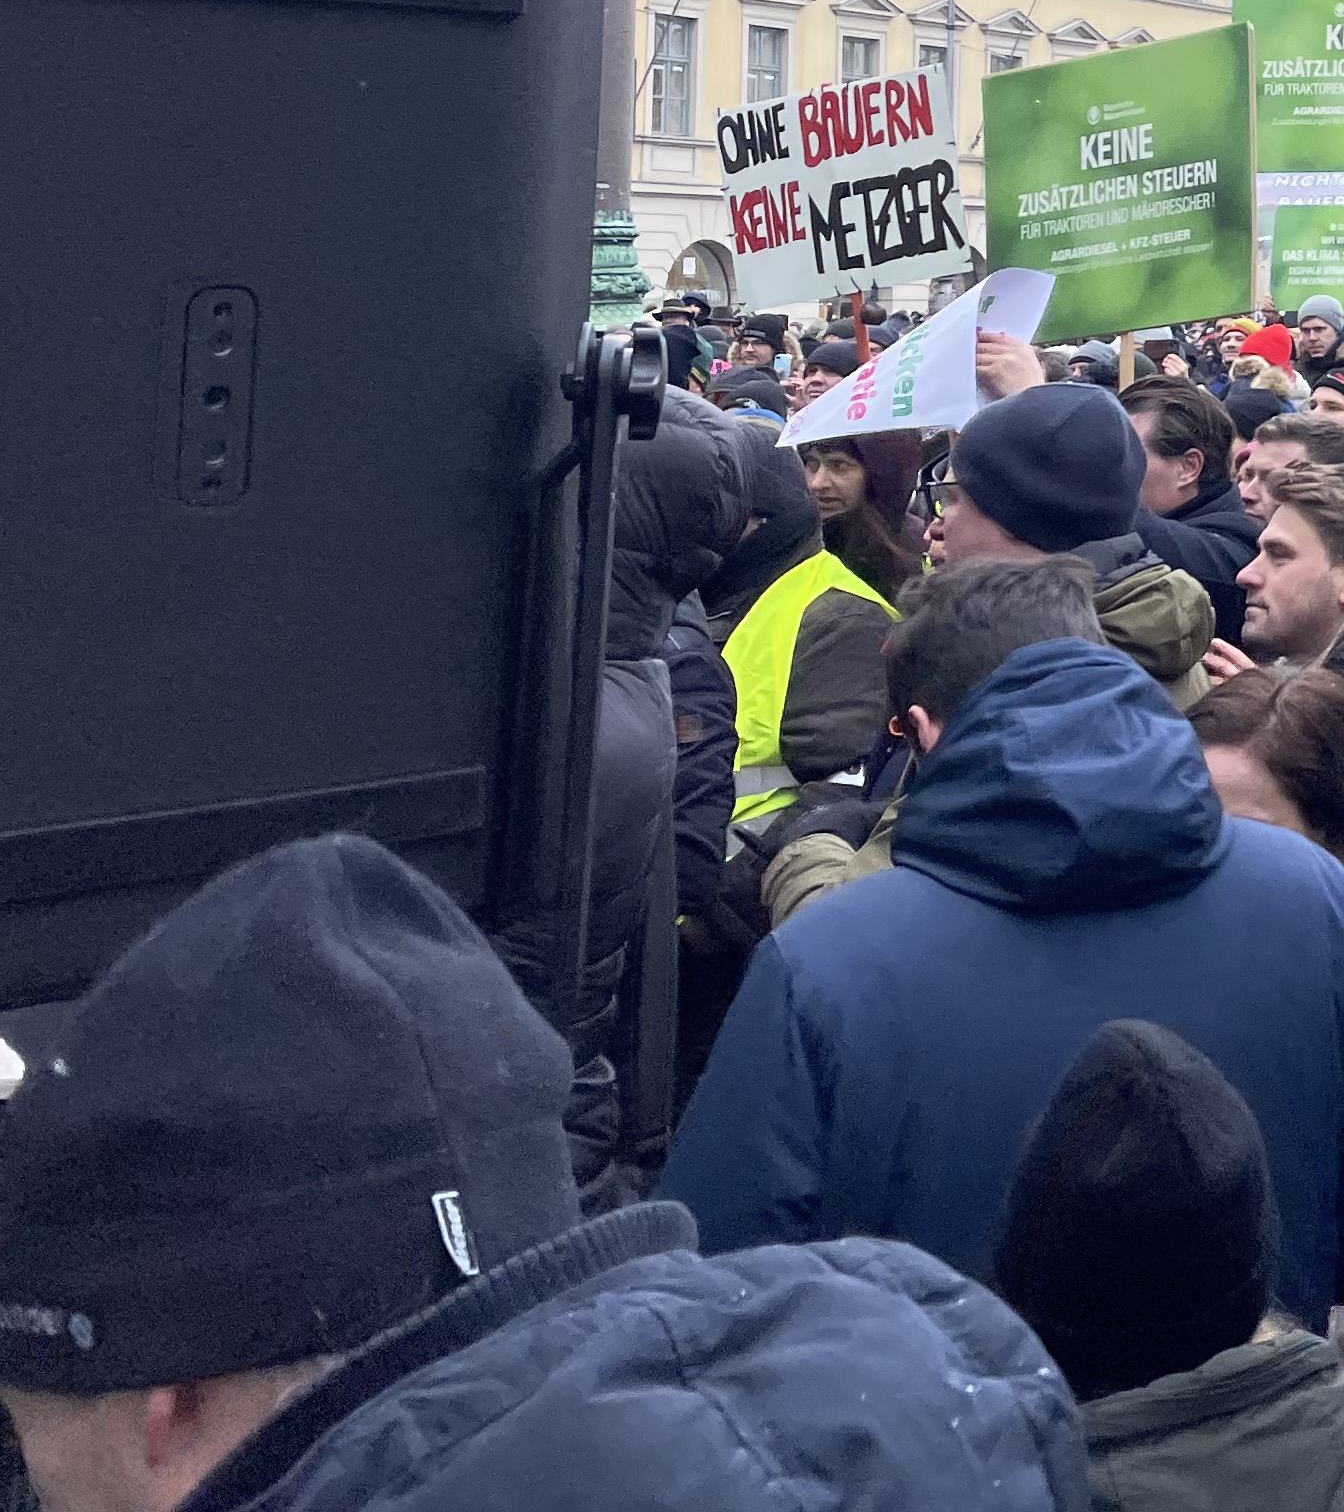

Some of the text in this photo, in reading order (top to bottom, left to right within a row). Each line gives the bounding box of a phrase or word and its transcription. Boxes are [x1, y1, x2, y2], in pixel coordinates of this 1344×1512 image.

[1264, 82, 1285, 96] FÜR
[717, 74, 935, 175] OHNE BAUERN
[1080, 123, 1154, 171] KEINE
[1018, 159, 1217, 217] ZUSÄTZLICHEN STEUERN
[730, 159, 966, 274] KEINE METZGER
[1020, 222, 1041, 240] FÜR
[1043, 213, 1104, 237] TRAKTOREN
[1107, 207, 1129, 226] UND
[1282, 249, 1304, 262] DAS
